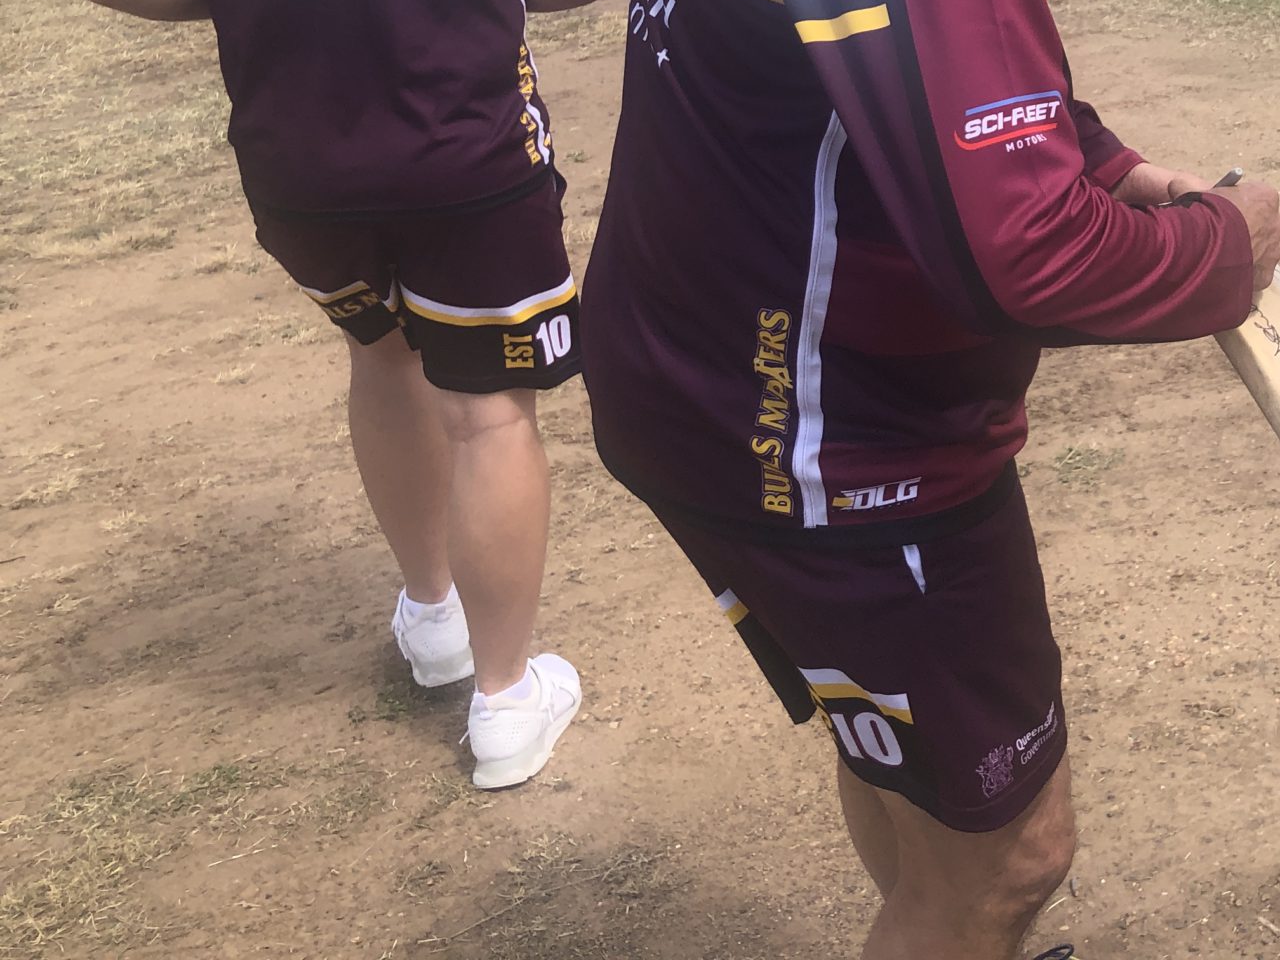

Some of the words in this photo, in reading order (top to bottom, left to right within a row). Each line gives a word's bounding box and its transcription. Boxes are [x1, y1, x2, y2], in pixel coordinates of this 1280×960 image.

[1004, 133, 1047, 153] MOTORS
[503, 333, 535, 369] EST
[535, 314, 572, 366] 10
[850, 477, 922, 511] DLG
[829, 711, 903, 766] 10
